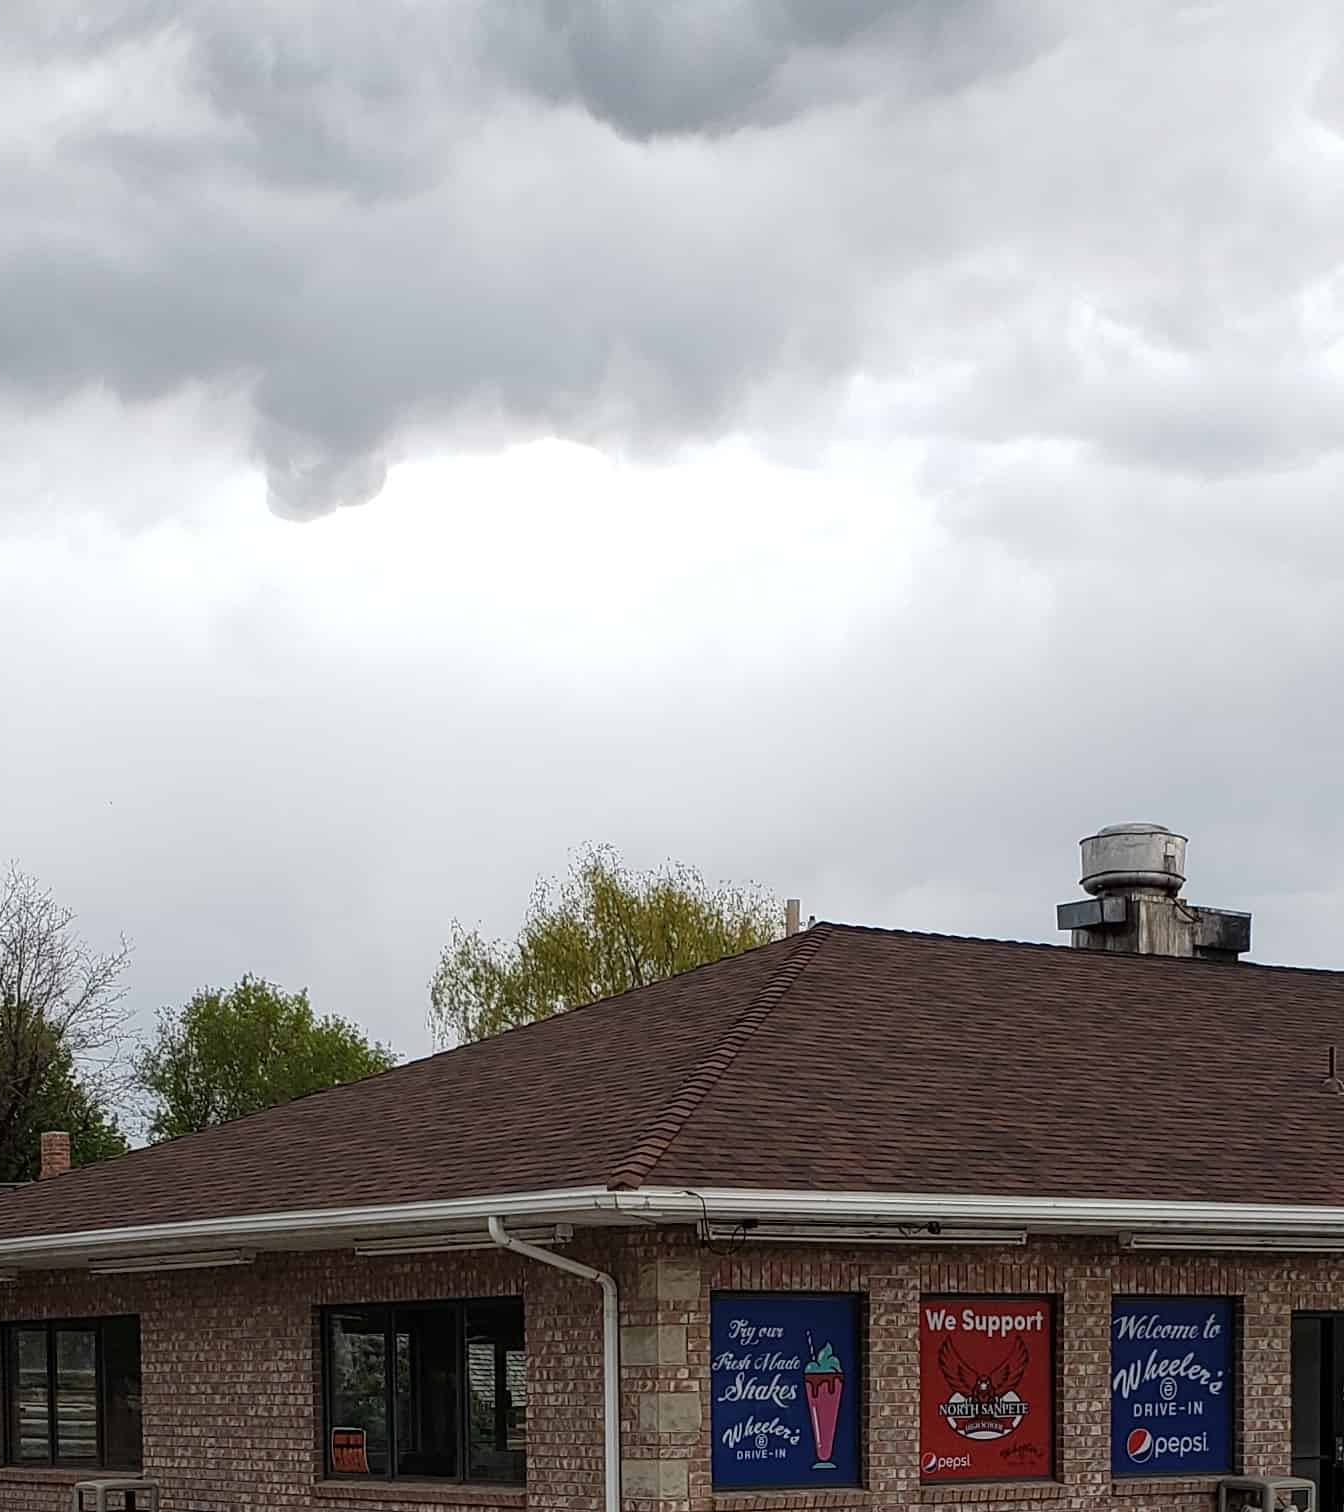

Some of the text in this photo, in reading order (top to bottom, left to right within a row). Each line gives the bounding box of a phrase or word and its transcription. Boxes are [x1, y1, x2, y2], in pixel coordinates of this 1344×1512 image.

[728, 1319, 784, 1346] Try our
[925, 1308, 1044, 1337] We Support
[1113, 1313, 1221, 1340] Welcome to
[712, 1351, 801, 1371] Fresh Made
[1113, 1349, 1224, 1399] Wheeler's
[718, 1372, 798, 1408] Shakes
[939, 1403, 1029, 1415] NORTH SANPETE
[1133, 1401, 1204, 1417] DRIVE-IN
[722, 1416, 801, 1449] Wheeler's
[1155, 1432, 1209, 1458] pepsi
[737, 1449, 786, 1460] DRIVE-IN
[937, 1454, 971, 1471] pepsi
